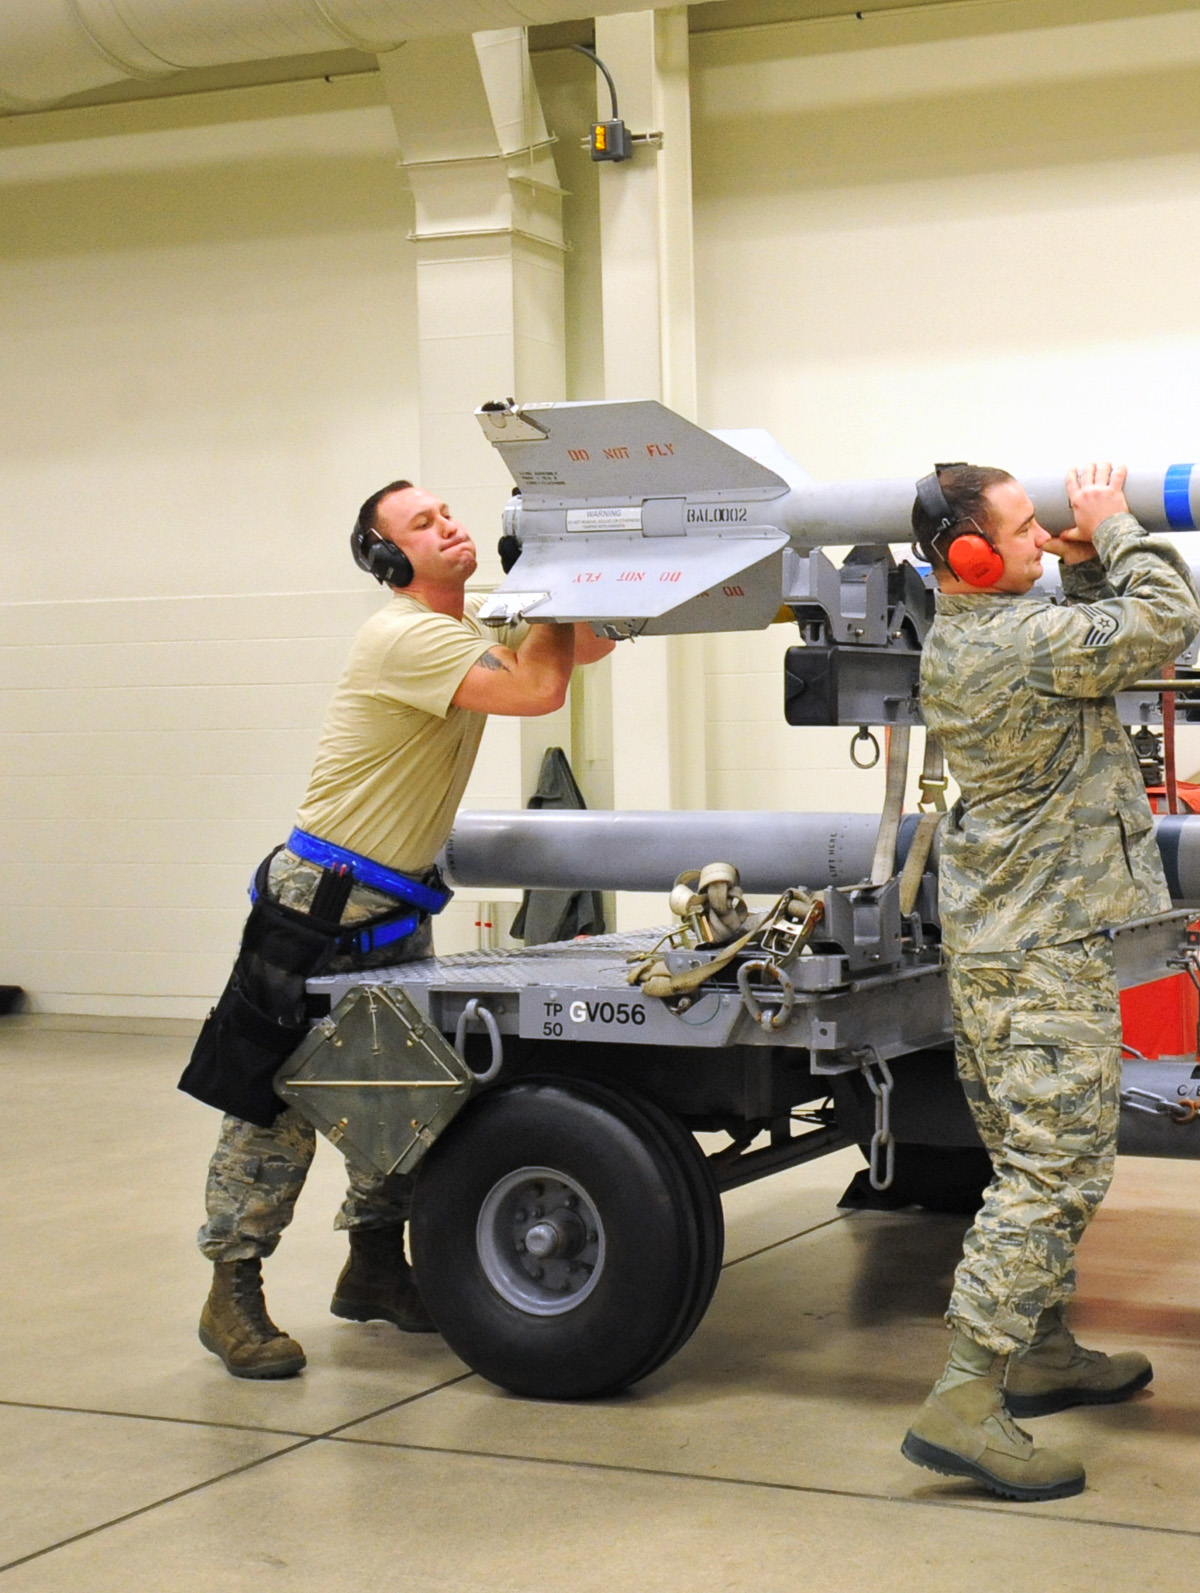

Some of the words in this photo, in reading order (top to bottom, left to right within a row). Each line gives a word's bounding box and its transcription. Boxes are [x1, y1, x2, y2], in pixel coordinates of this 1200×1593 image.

[568, 449, 590, 461] DO
[603, 447, 630, 460] NOT
[646, 443, 674, 457] FLY
[572, 573, 602, 583] FLY
[616, 572, 645, 582] NOT
[659, 571, 683, 582] DO
[828, 832, 837, 855] HERE
[828, 859, 837, 877] LIFT
[543, 1002, 563, 1017] TP
[569, 1001, 646, 1026] GV056
[543, 1021, 563, 1037] 50
